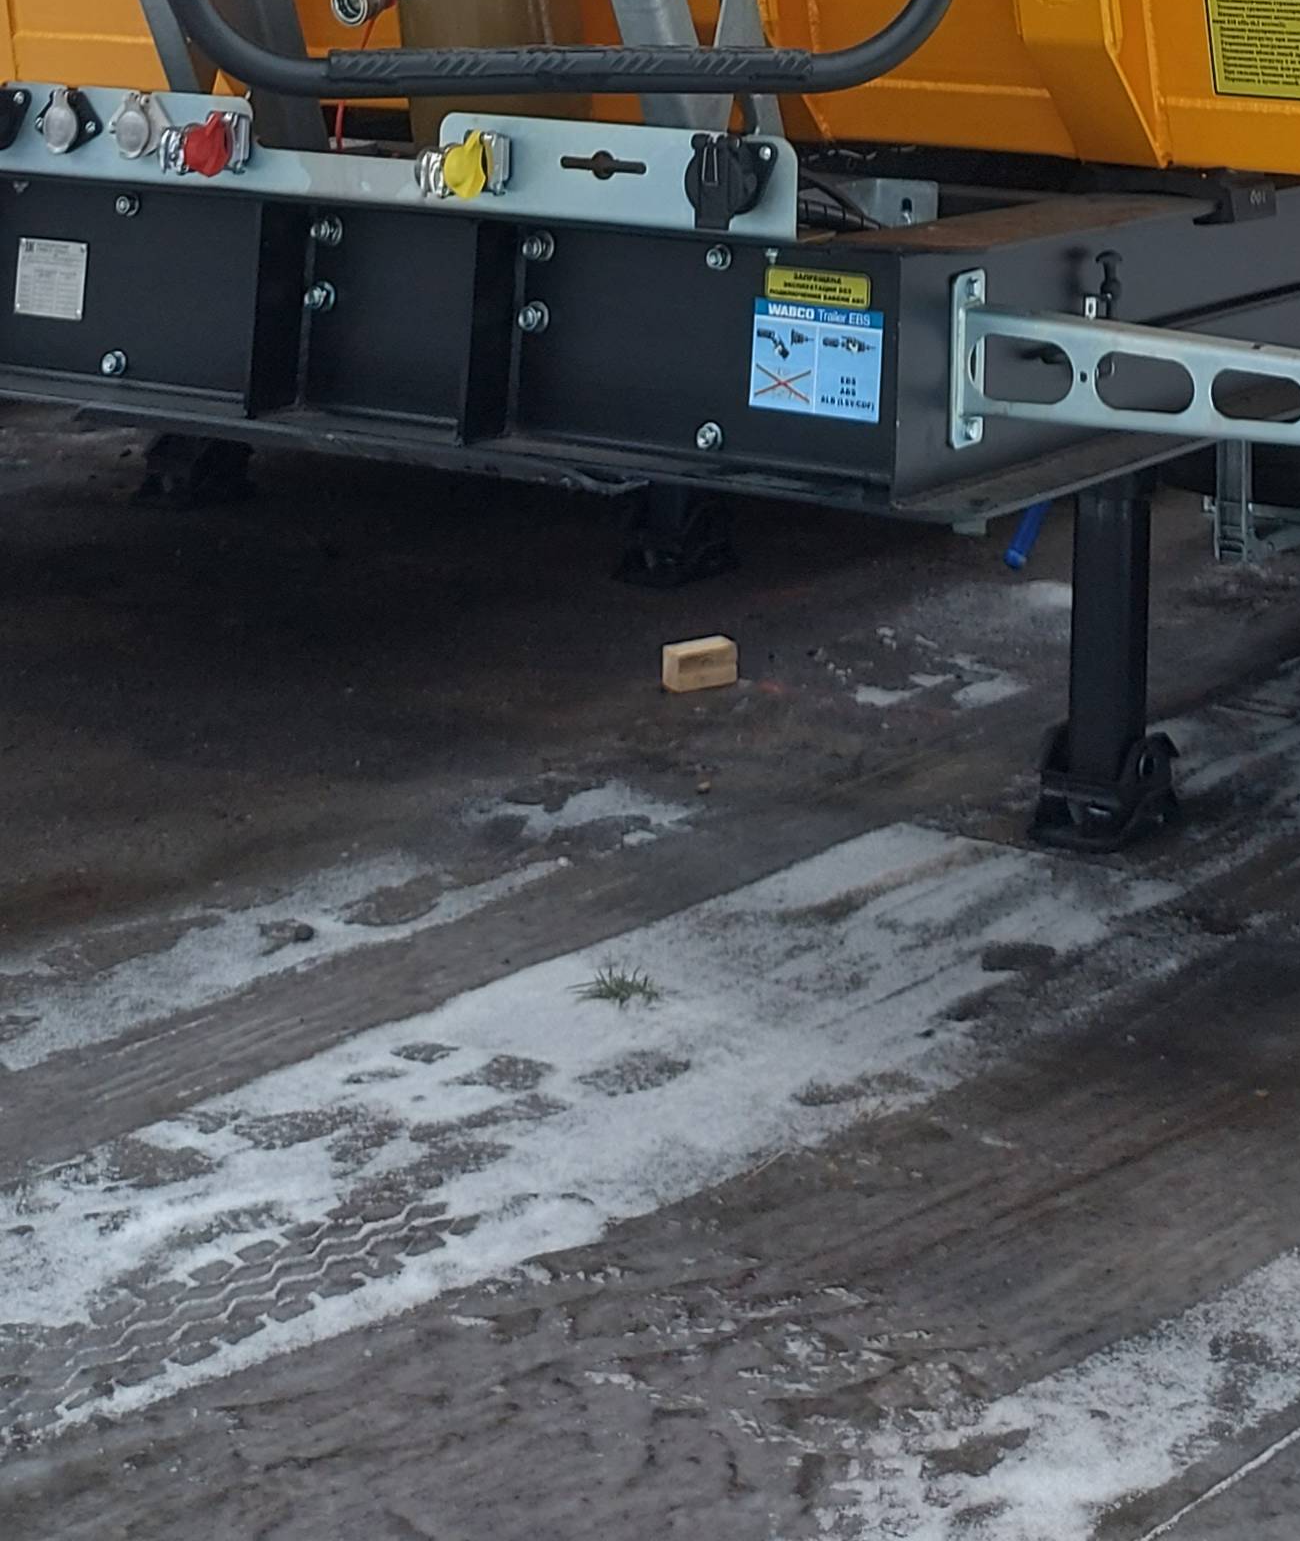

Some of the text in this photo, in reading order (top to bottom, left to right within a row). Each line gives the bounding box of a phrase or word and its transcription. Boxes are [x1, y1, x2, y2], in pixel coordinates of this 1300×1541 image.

[768, 303, 871, 327] WABCO Trailer EBS
